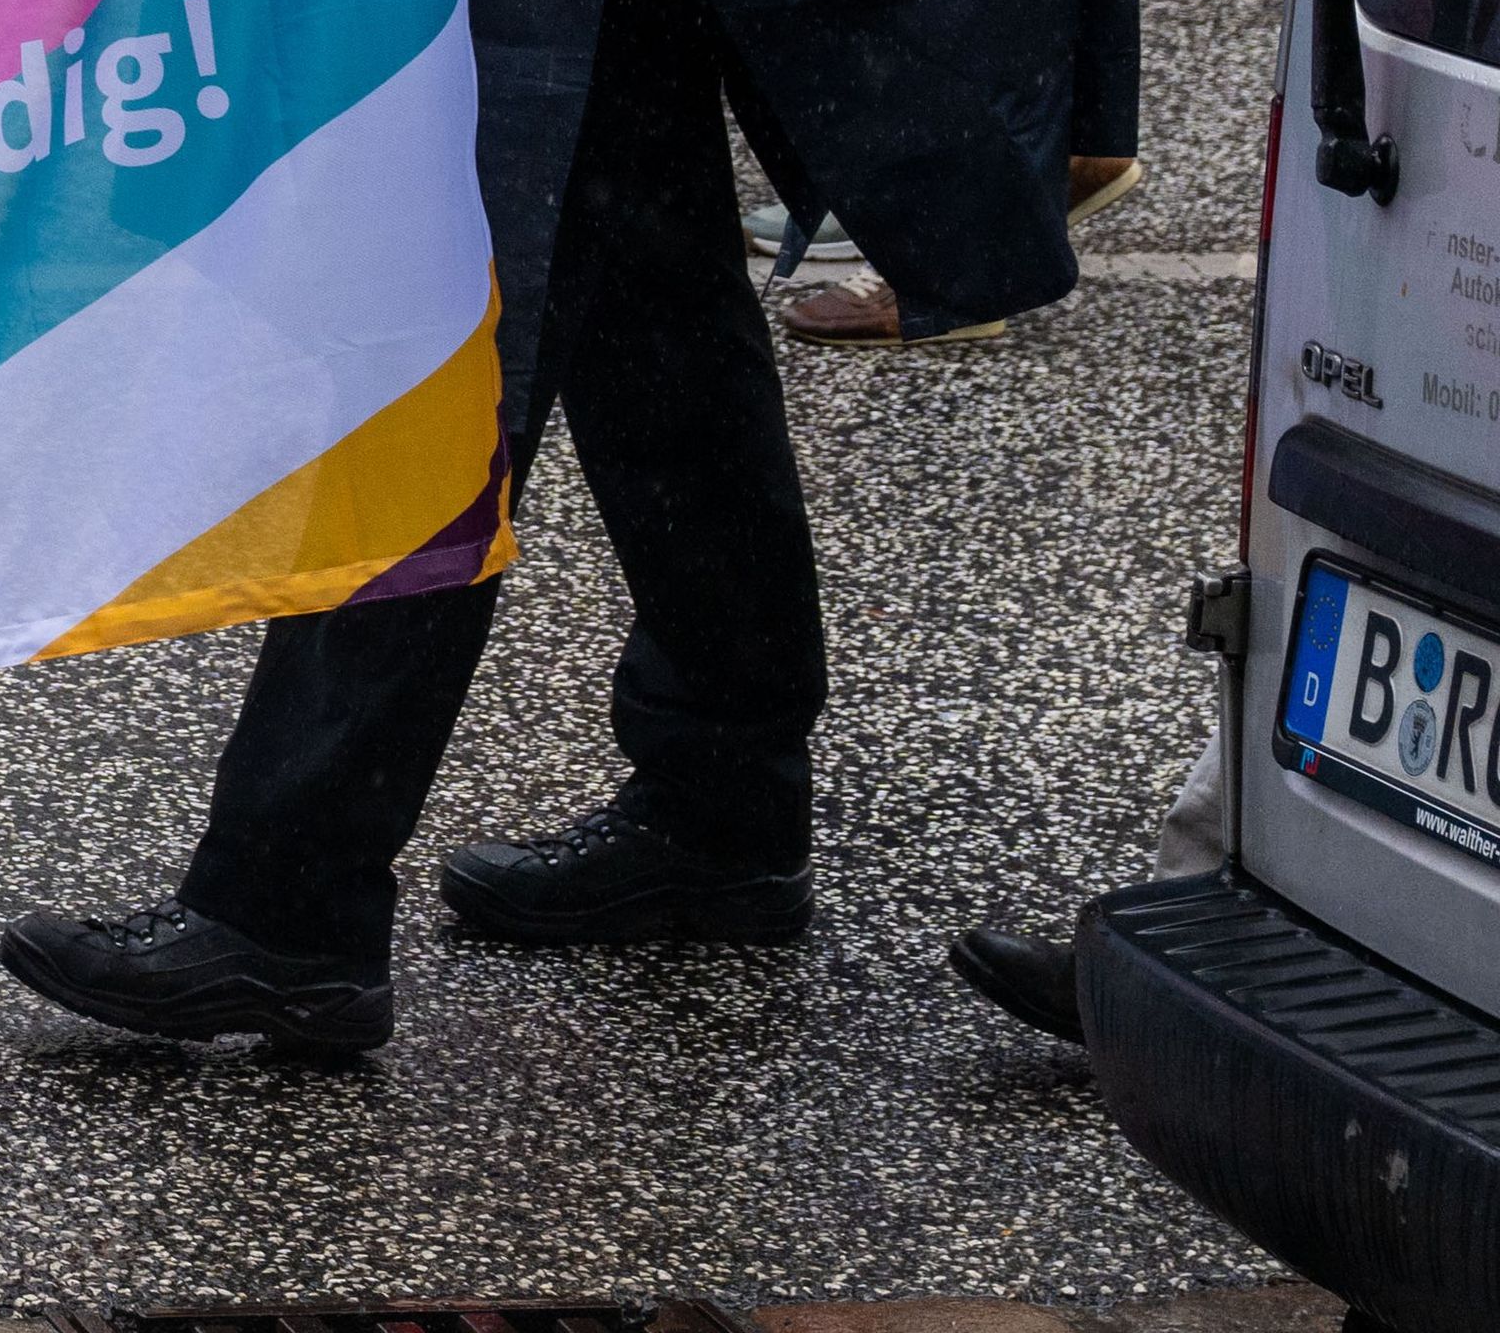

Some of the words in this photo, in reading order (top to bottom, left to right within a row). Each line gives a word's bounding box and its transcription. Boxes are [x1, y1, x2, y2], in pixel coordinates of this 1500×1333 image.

[1301, 339, 1384, 411] OPEL
[1422, 371, 1482, 419] Mobil:
[1303, 671, 1320, 708] D
[1349, 610, 1403, 747] B
